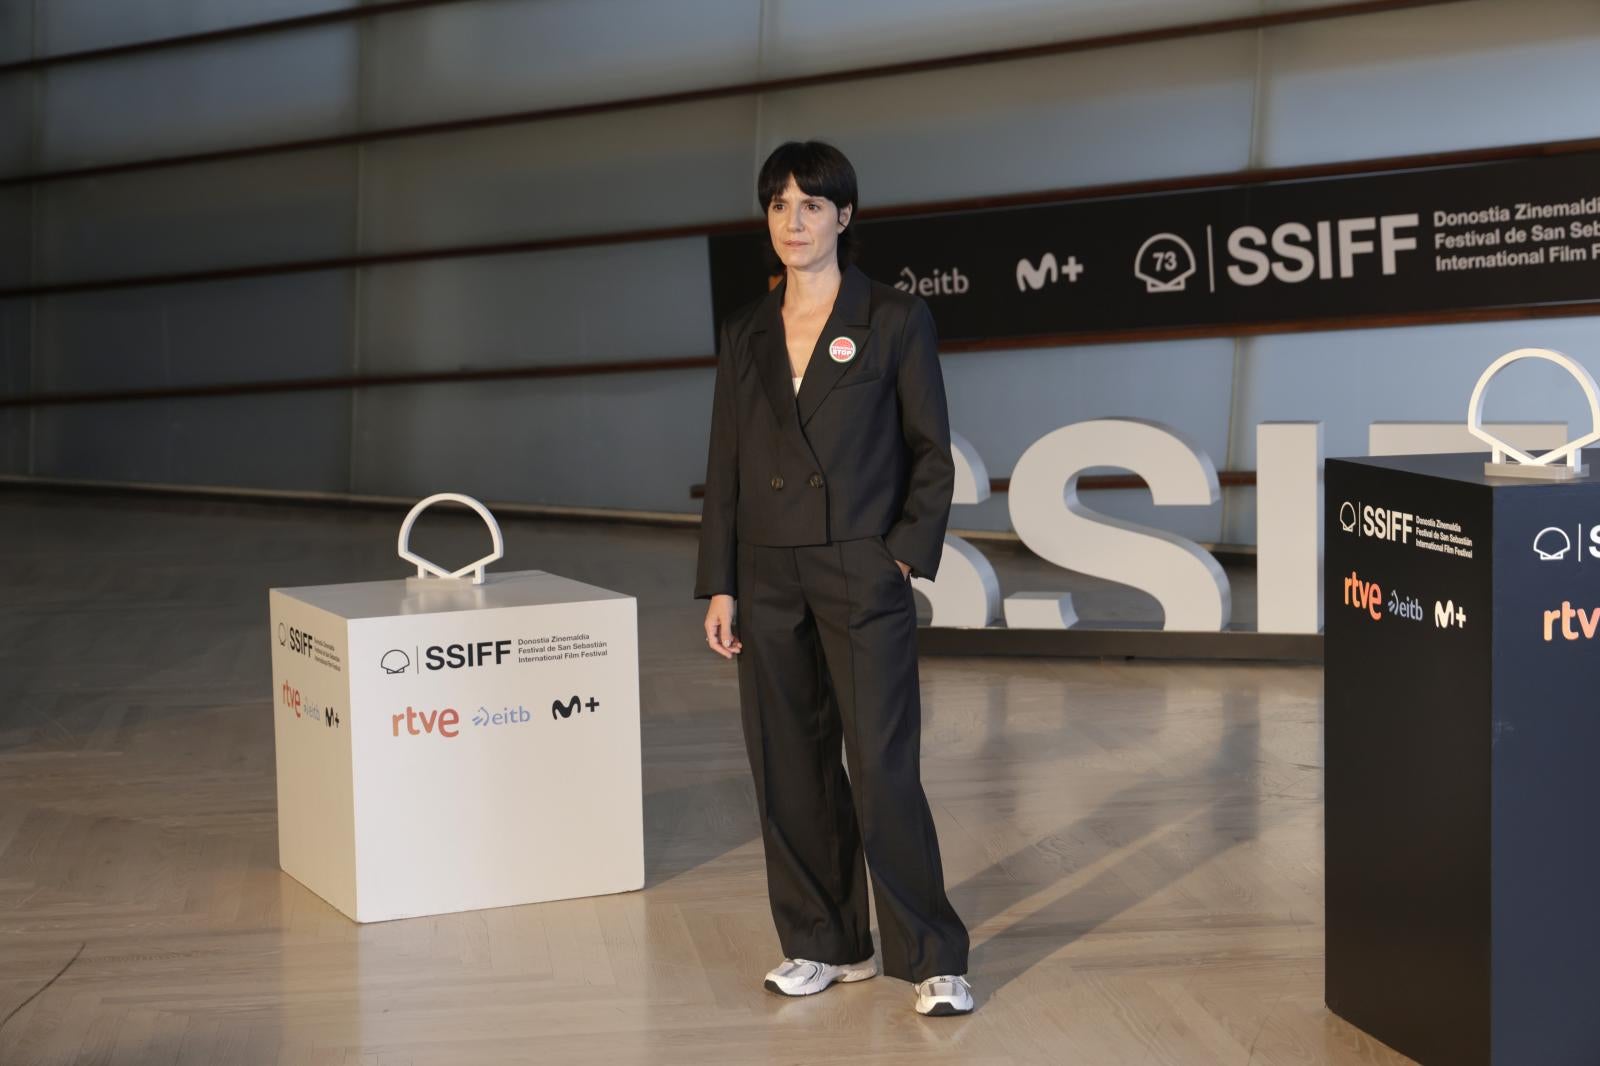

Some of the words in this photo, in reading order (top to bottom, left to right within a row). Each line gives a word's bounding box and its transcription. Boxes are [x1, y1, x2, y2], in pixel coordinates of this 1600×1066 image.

[1433, 205, 1510, 227] Donostia
[1227, 203, 1419, 286] SSIFF
[1434, 228, 1500, 249] Festival
[1504, 226, 1527, 244] de
[1531, 224, 1565, 242] San
[1152, 251, 1177, 272] 73
[1435, 248, 1545, 272] International
[1549, 244, 1587, 263] Film
[918, 267, 969, 296] eitb
[1363, 505, 1413, 544] SSIFF
[1344, 571, 1382, 620] rtve
[1399, 596, 1423, 621] eitb
[1435, 600, 1466, 628] M+
[1543, 600, 1600, 641] rtv
[289, 626, 313, 658] SSIFF
[518, 636, 549, 646] Donostia
[551, 632, 589, 643] Zinemaldia
[518, 645, 546, 655] Festival
[547, 644, 556, 652] de
[557, 643, 571, 651] San
[425, 640, 511, 670] SSIFF
[518, 653, 563, 663] International
[564, 652, 579, 660] Film
[581, 649, 608, 658] Festival
[283, 680, 301, 718] rtve
[392, 706, 459, 738] rtve
[492, 706, 531, 725] eitb
[552, 695, 599, 720] M+
